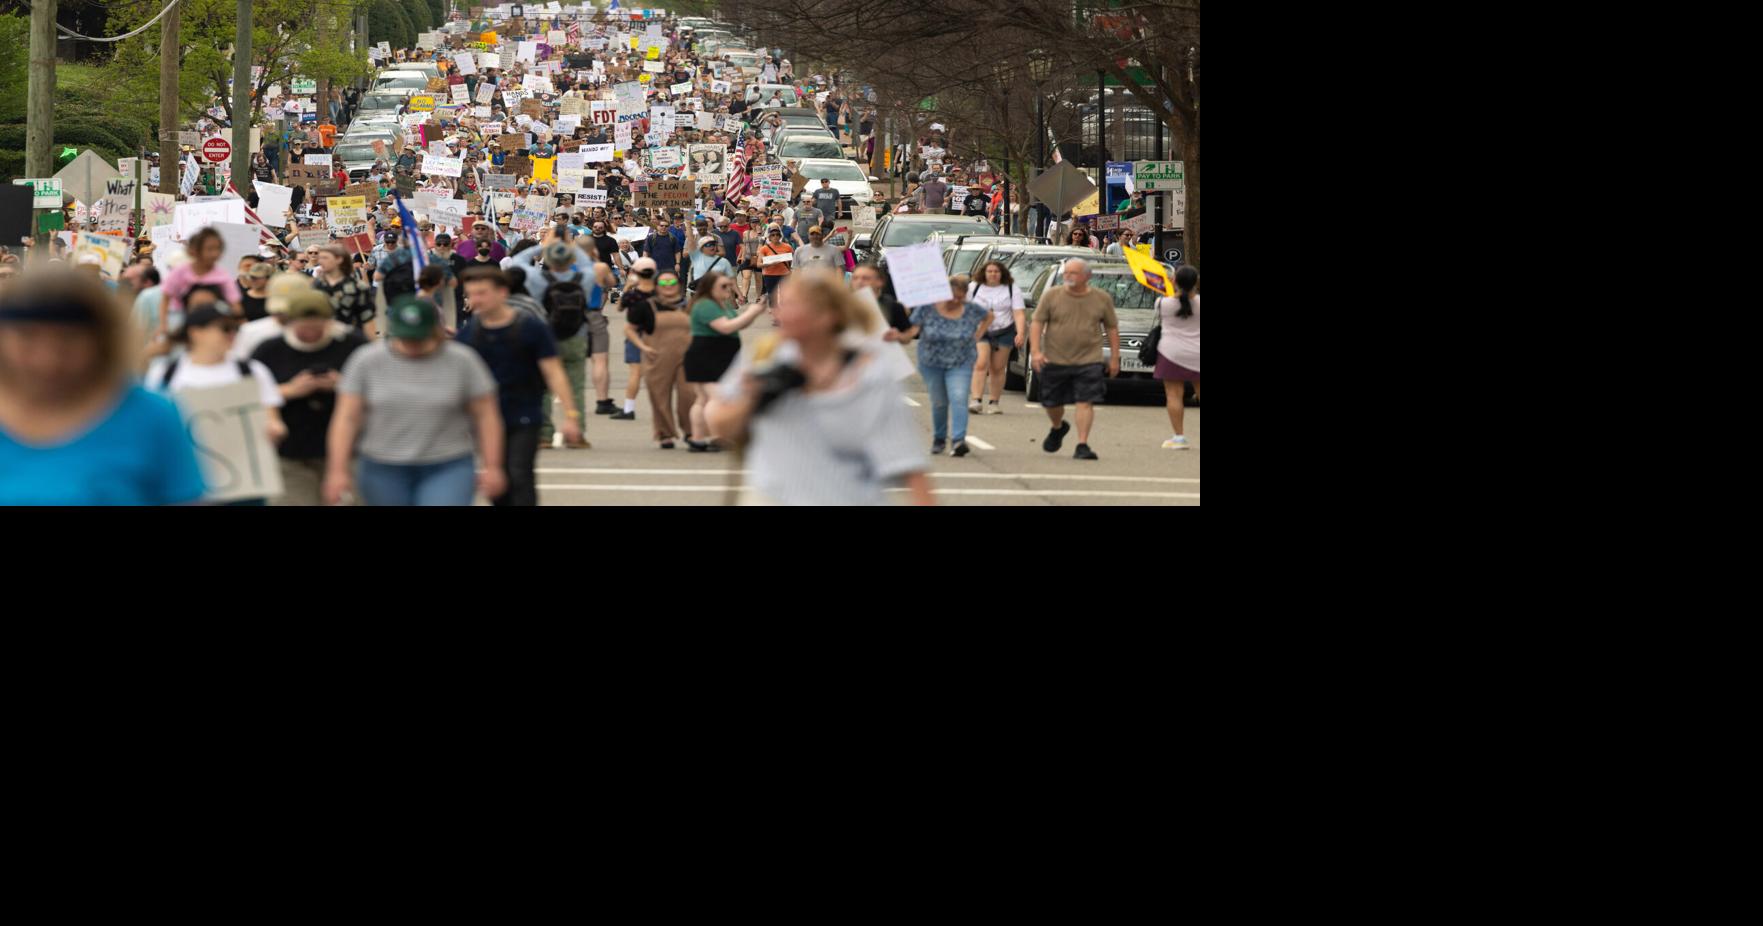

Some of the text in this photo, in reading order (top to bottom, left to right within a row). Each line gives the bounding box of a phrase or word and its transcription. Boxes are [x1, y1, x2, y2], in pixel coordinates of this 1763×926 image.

[593, 110, 616, 124] FDT
[107, 179, 135, 195] What
[658, 182, 678, 191] ELON
[104, 199, 128, 216] the
[639, 199, 647, 207] HE
[670, 199, 679, 207] IN
[682, 199, 692, 207] ON
[1169, 250, 1178, 260] P
